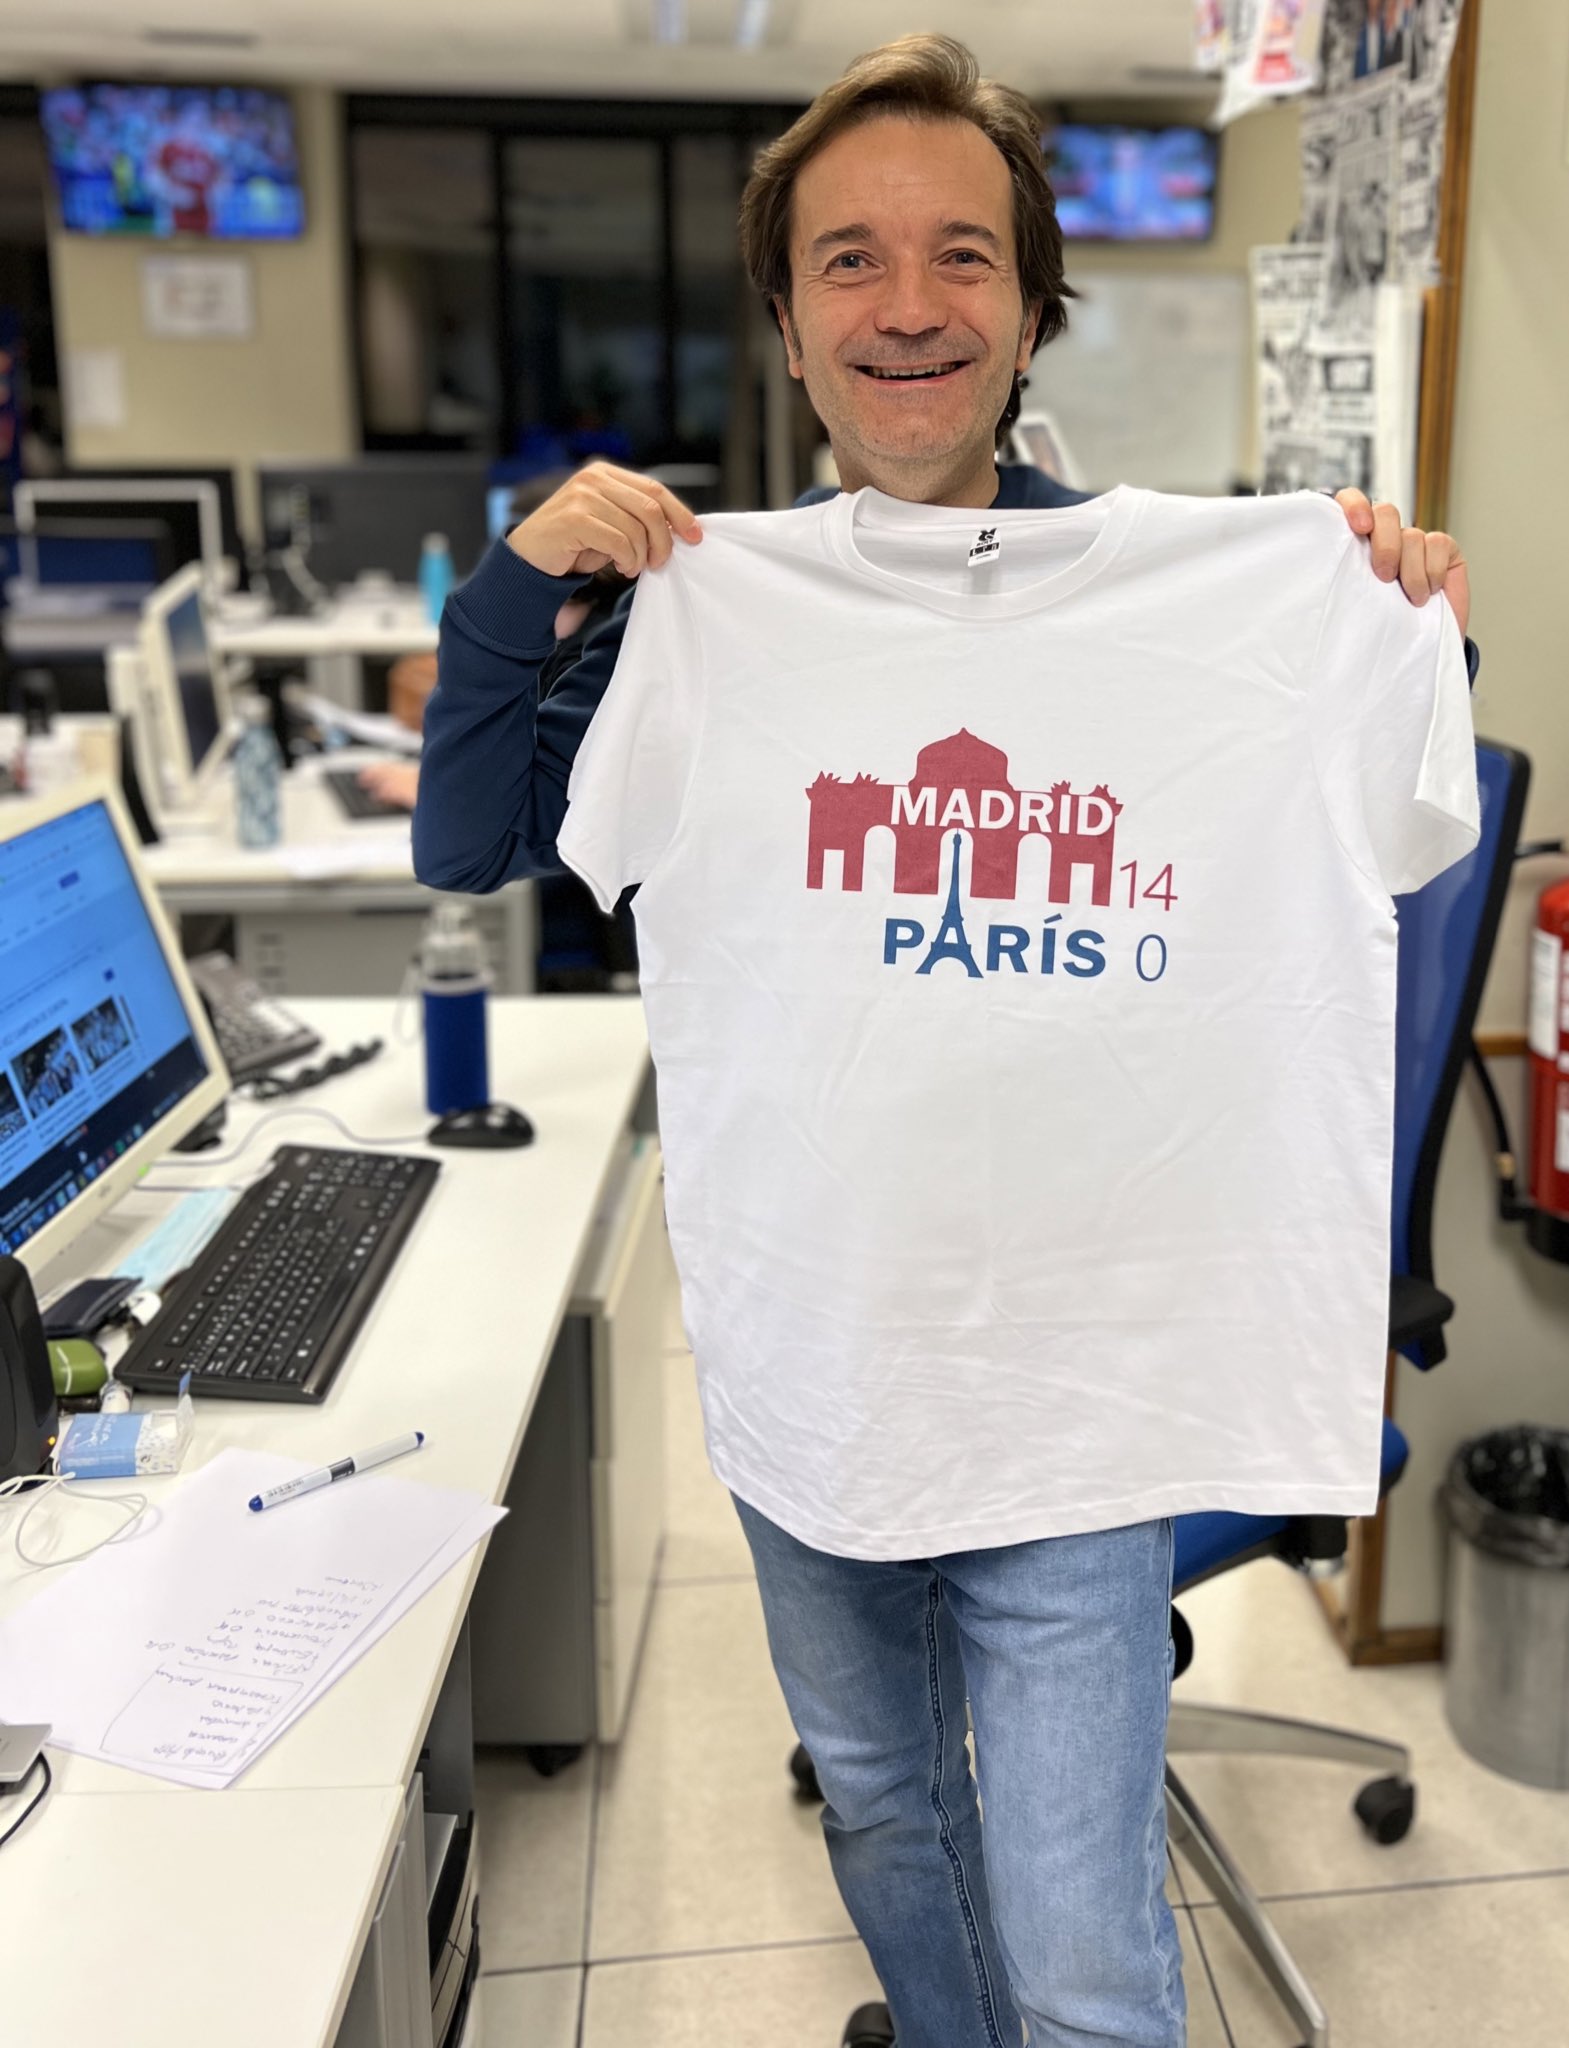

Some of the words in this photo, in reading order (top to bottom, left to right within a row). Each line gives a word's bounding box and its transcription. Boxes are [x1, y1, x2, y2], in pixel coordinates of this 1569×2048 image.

[890, 785, 1113, 836] MADRID
[1119, 859, 1179, 912] 14
[883, 911, 1106, 979] PARÍS
[1135, 933, 1168, 982] 0
